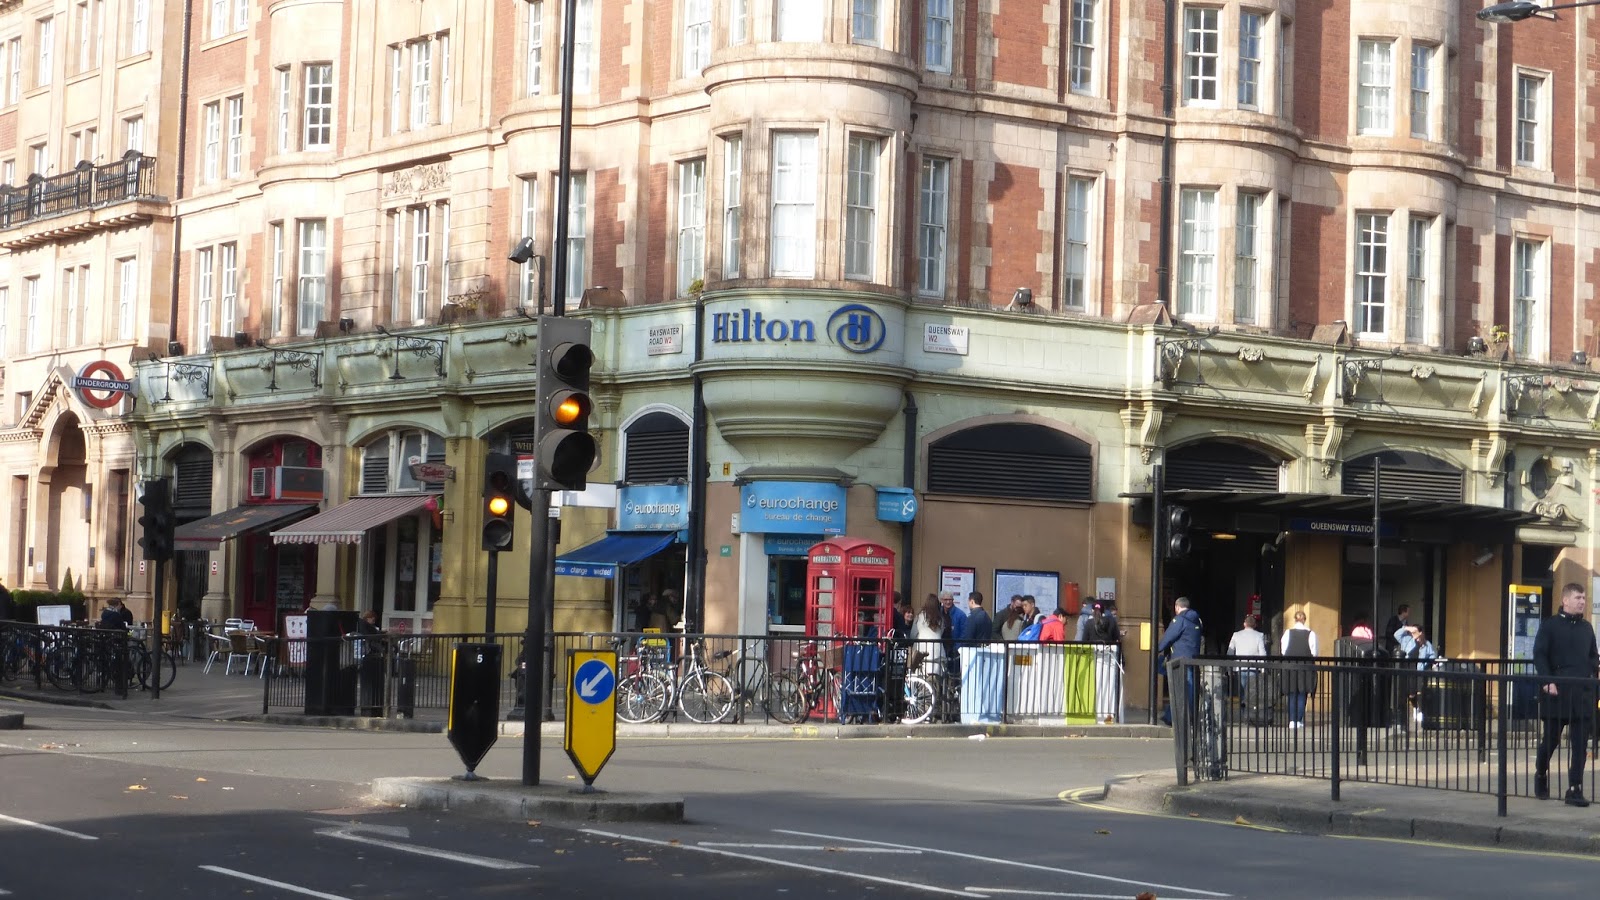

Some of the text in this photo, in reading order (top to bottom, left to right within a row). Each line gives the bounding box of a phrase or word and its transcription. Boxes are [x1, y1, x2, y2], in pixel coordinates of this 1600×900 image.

[712, 308, 817, 342] Hilton
[649, 327, 680, 337] BAYSWATER
[928, 325, 965, 336] QUEENSWAY
[649, 336, 672, 346] ROAD W2
[928, 335, 938, 343] W2
[77, 379, 129, 390] UNDERGROUND
[515, 441, 534, 451] WHI
[634, 500, 680, 516] eurochange
[759, 496, 838, 512] eurochange
[764, 512, 790, 520] bureau
[806, 513, 832, 522] change
[1310, 522, 1349, 531] QUEENSWAY
[851, 557, 889, 565] TELEPHONE
[570, 566, 588, 575] change
[476, 654, 483, 664] 5
